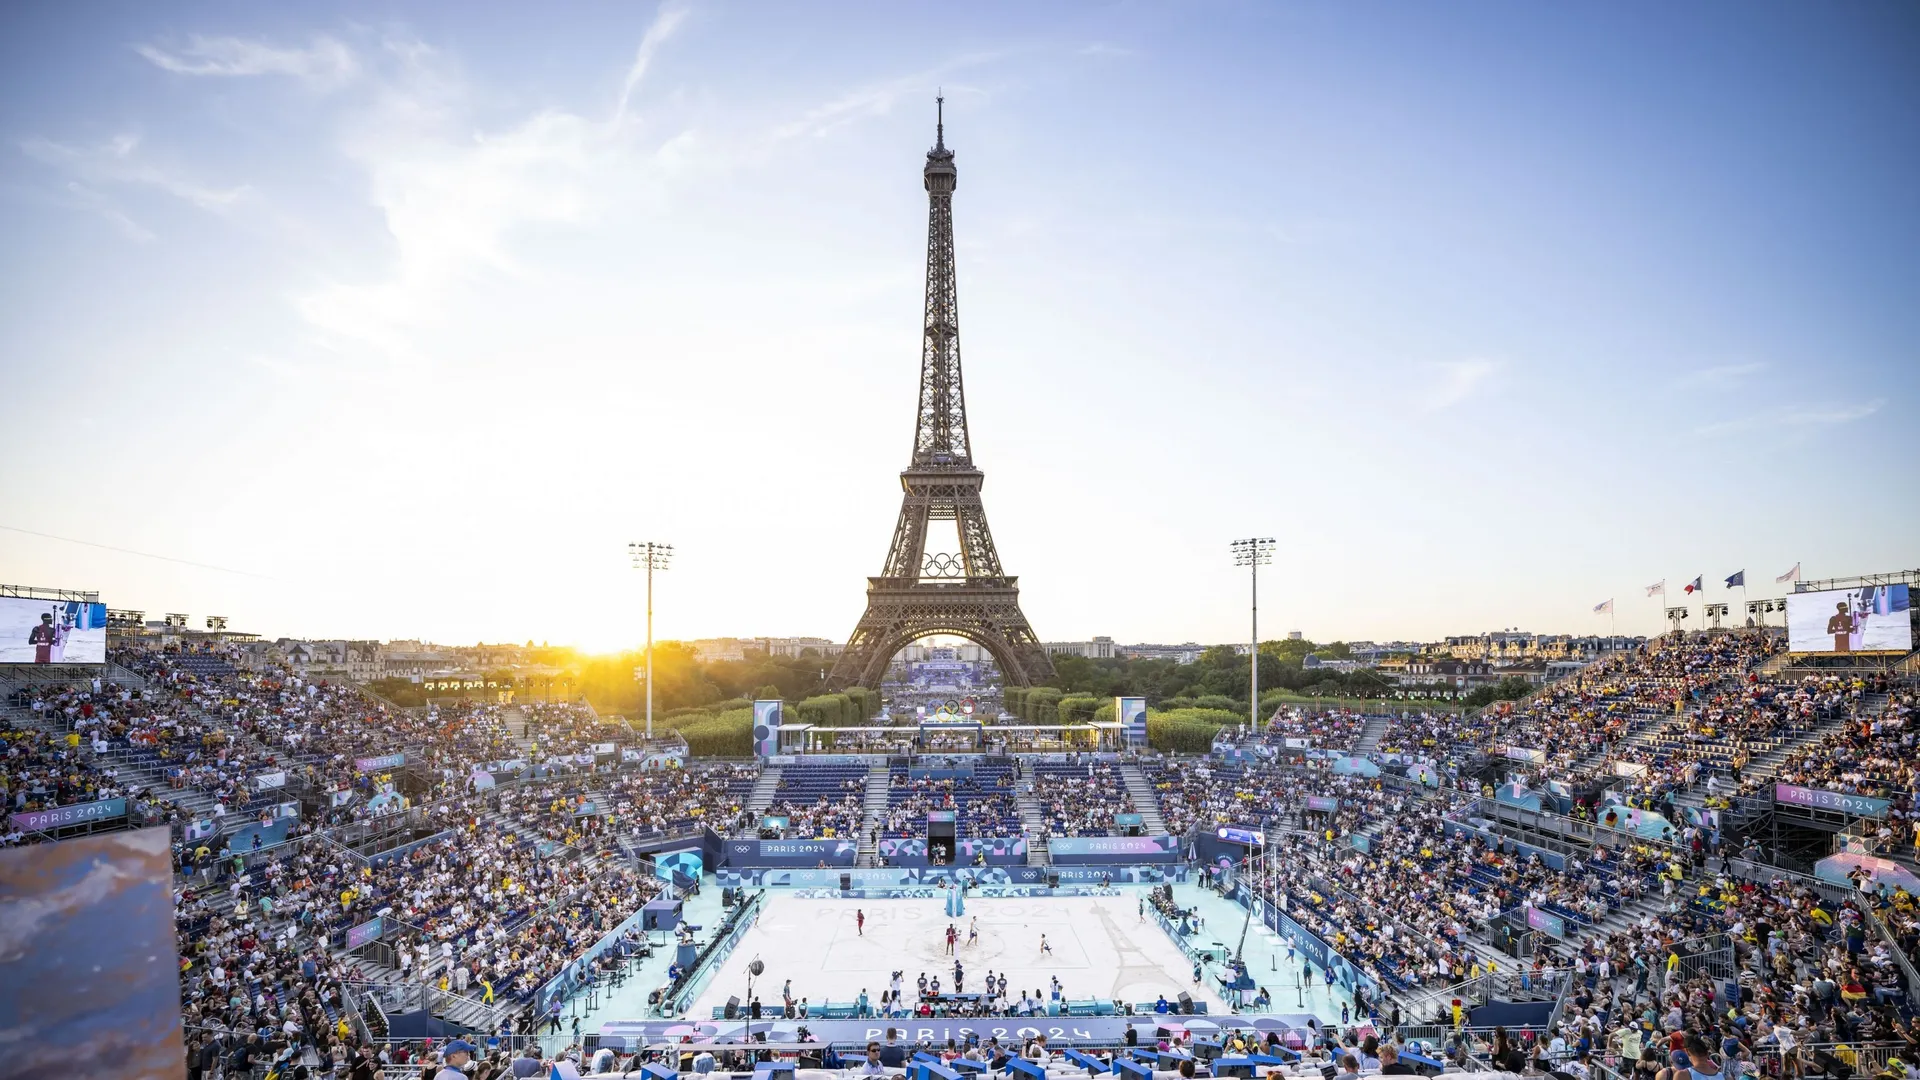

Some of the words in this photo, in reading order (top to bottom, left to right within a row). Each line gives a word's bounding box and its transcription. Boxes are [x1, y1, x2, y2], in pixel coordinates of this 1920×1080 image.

[1834, 797, 1873, 811] 2024
[77, 805, 111, 818] 2024
[767, 845, 796, 853] PARIS
[799, 845, 825, 853] 2024
[1089, 842, 1118, 850] PARIS
[1120, 842, 1146, 850] 2024
[833, 872, 862, 880] PIS
[866, 872, 893, 880] 2024
[1087, 870, 1114, 879] 2024
[1305, 940, 1323, 960] 2024
[992, 1027, 1091, 1040] 2024
